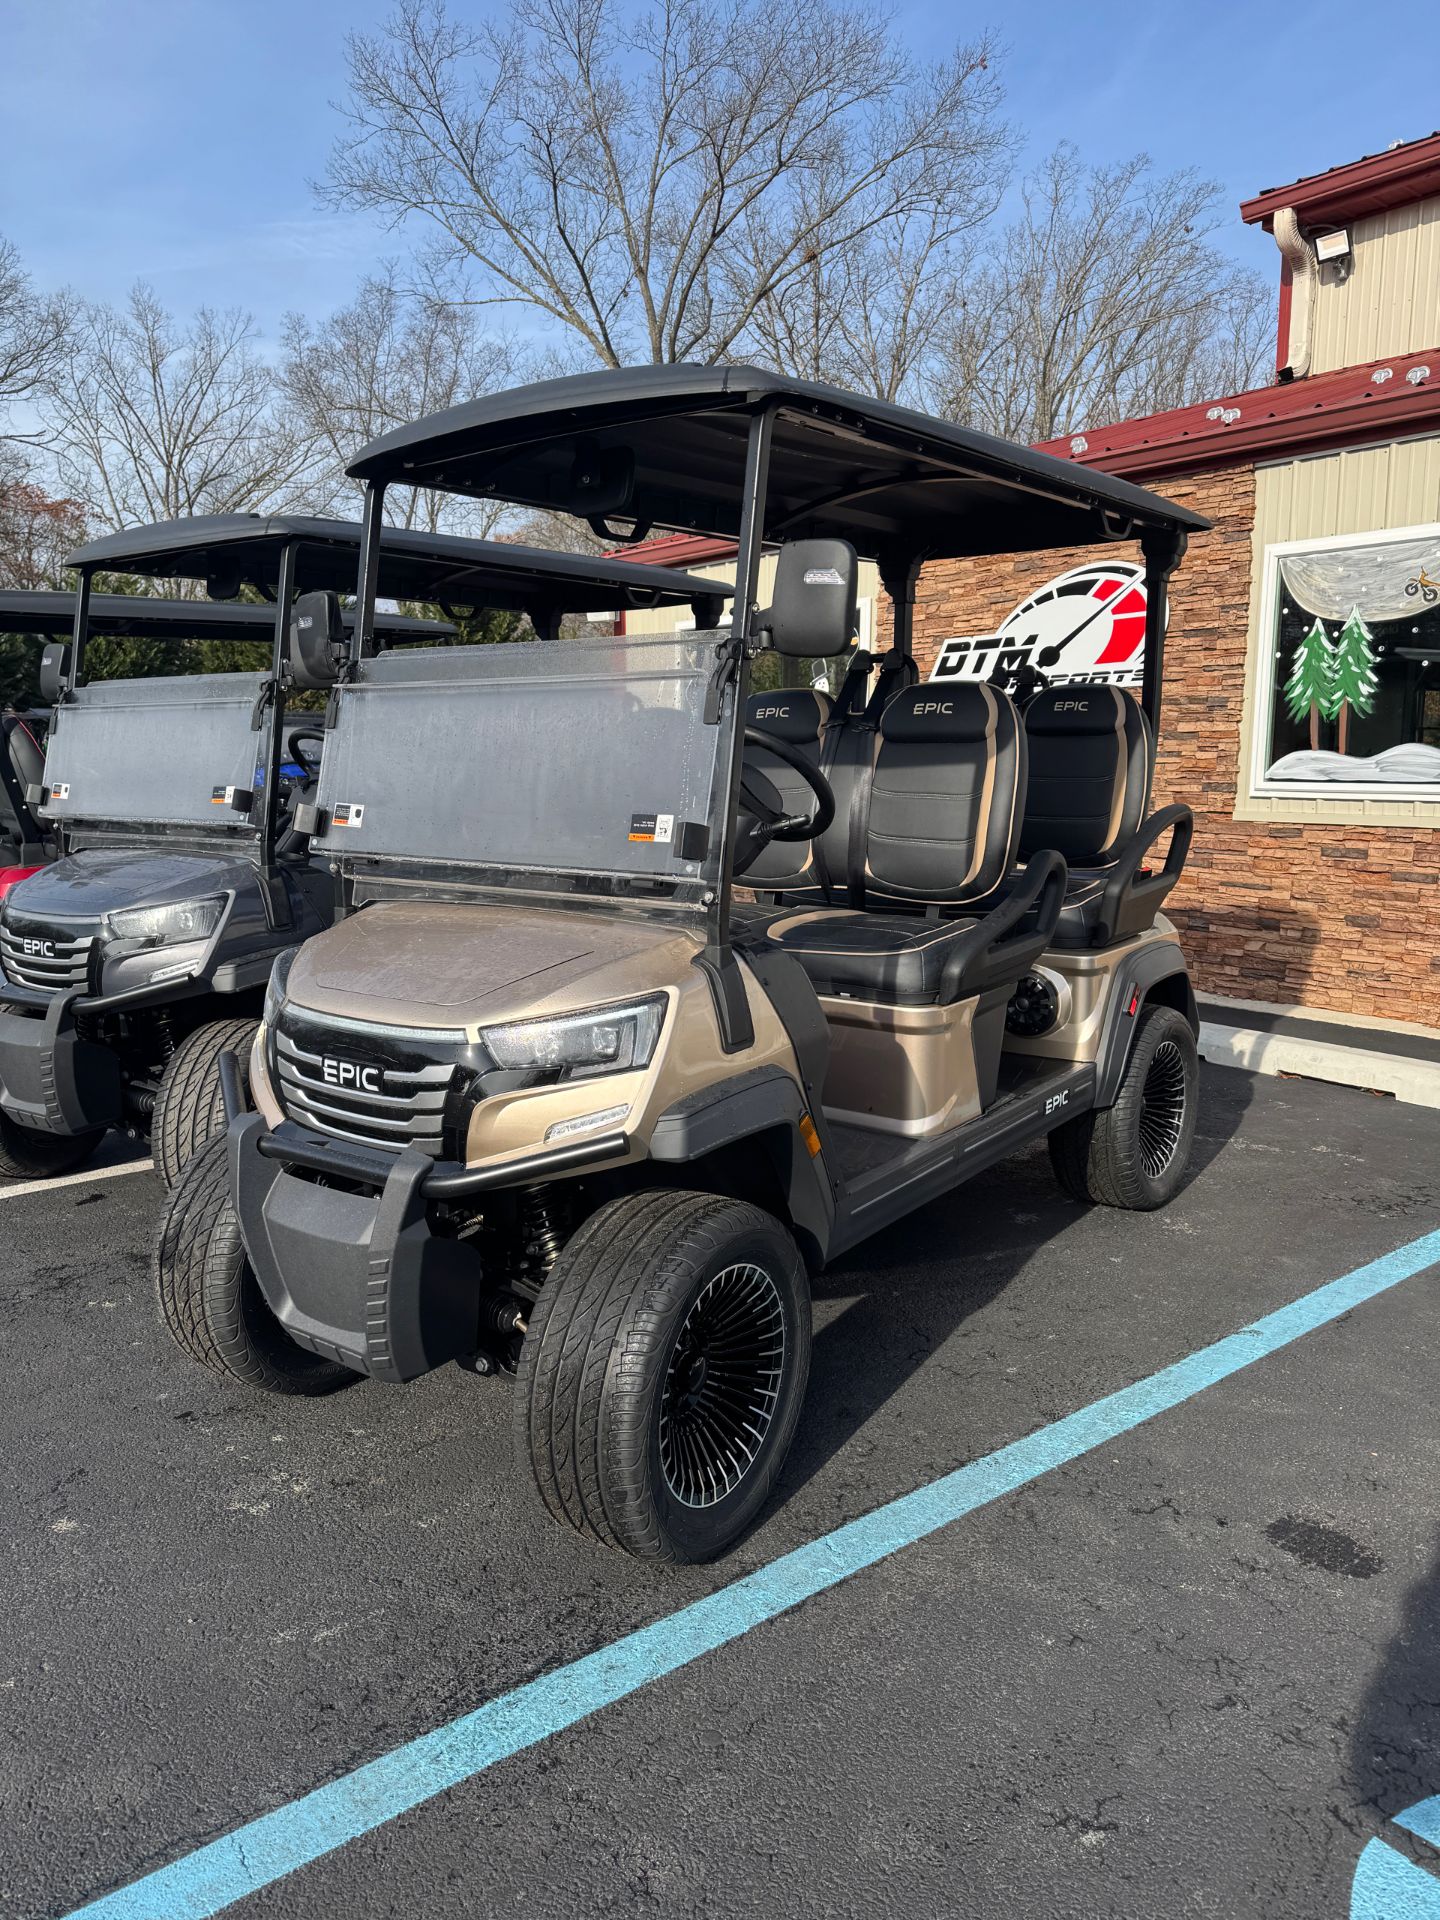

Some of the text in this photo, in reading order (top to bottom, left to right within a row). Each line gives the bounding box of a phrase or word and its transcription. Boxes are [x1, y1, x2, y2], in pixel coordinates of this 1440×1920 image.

[935, 634, 1039, 676] DTM
[755, 707, 790, 719] EPIC
[913, 703, 954, 715] EPIC
[1053, 701, 1089, 712] EPIC
[23, 939, 55, 957] EPIC
[323, 1058, 379, 1092] EPIC
[1045, 1090, 1069, 1115] EPIC
